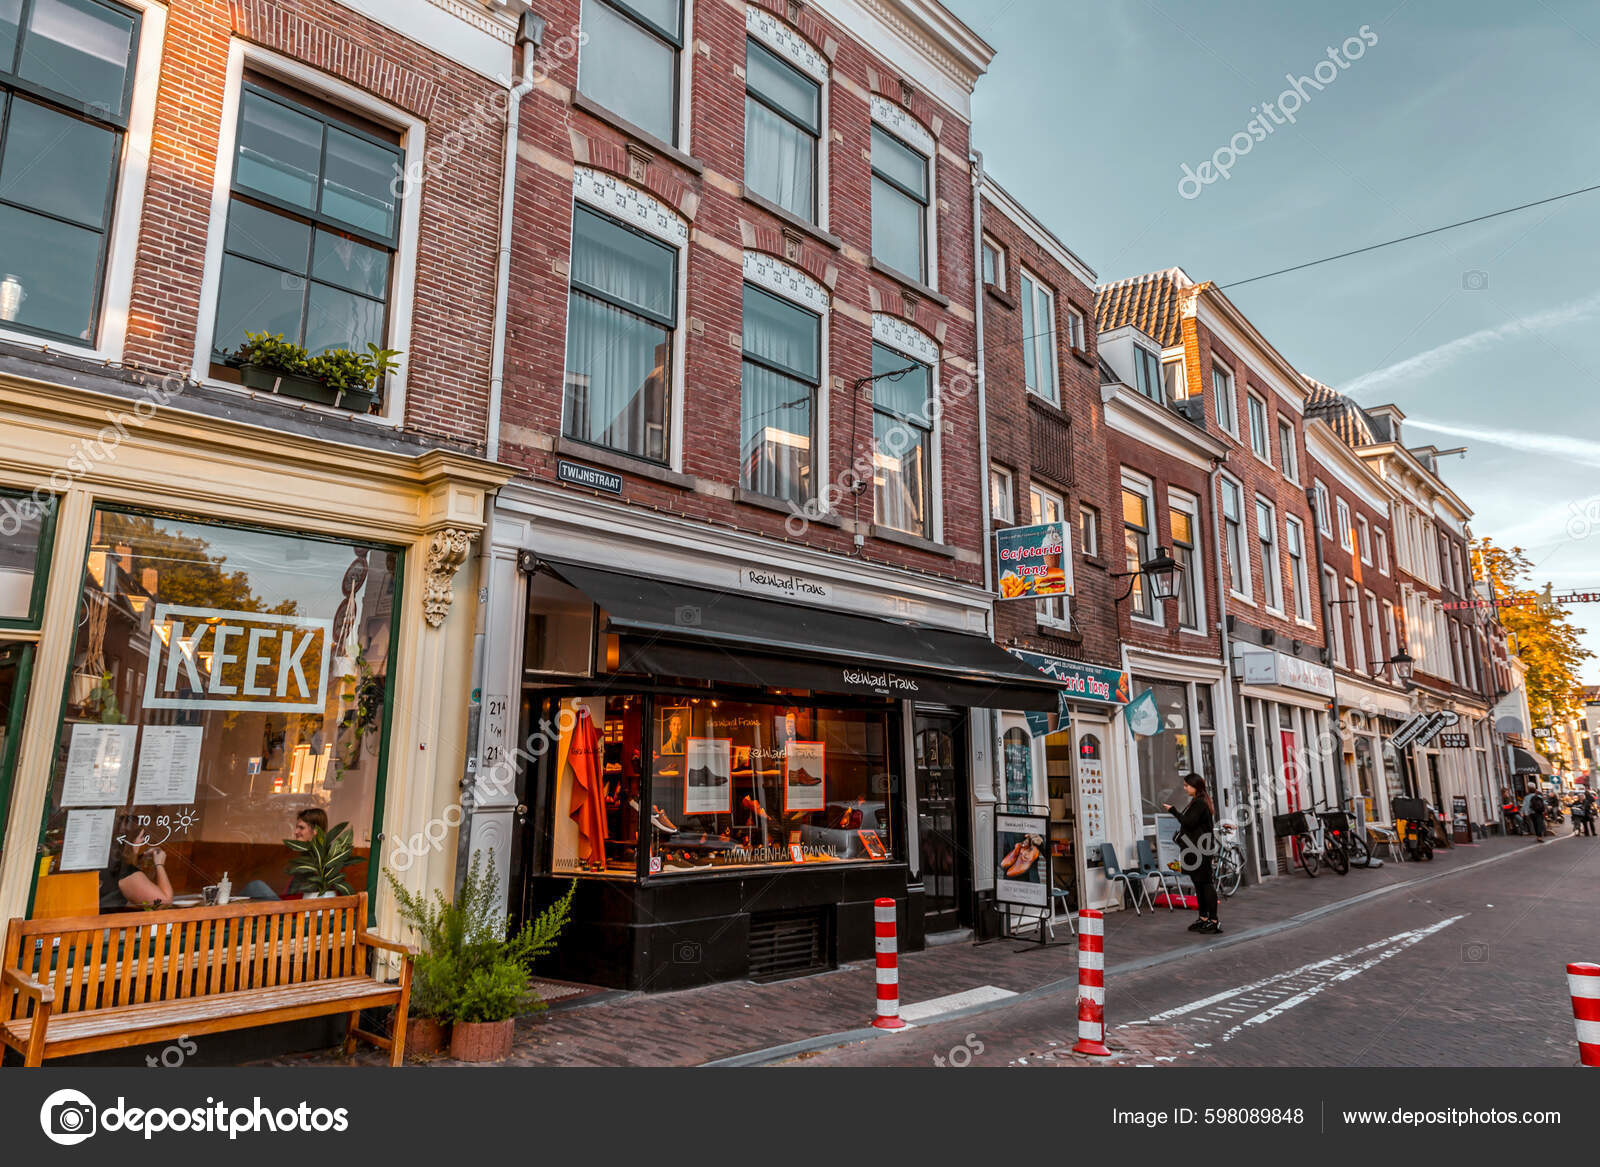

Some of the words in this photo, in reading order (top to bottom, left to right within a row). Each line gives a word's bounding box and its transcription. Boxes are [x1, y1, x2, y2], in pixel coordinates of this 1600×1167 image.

[562, 465, 620, 489] TWIJNSTRAAT
[1001, 544, 1062, 560] Cafetaria
[1017, 565, 1048, 577] Tang
[796, 579, 825, 596] Frans
[164, 621, 315, 698] KEEK
[889, 674, 919, 691] Frans
[1088, 676, 1109, 700] Tang
[137, 815, 150, 826] TO
[156, 815, 170, 826] GO
